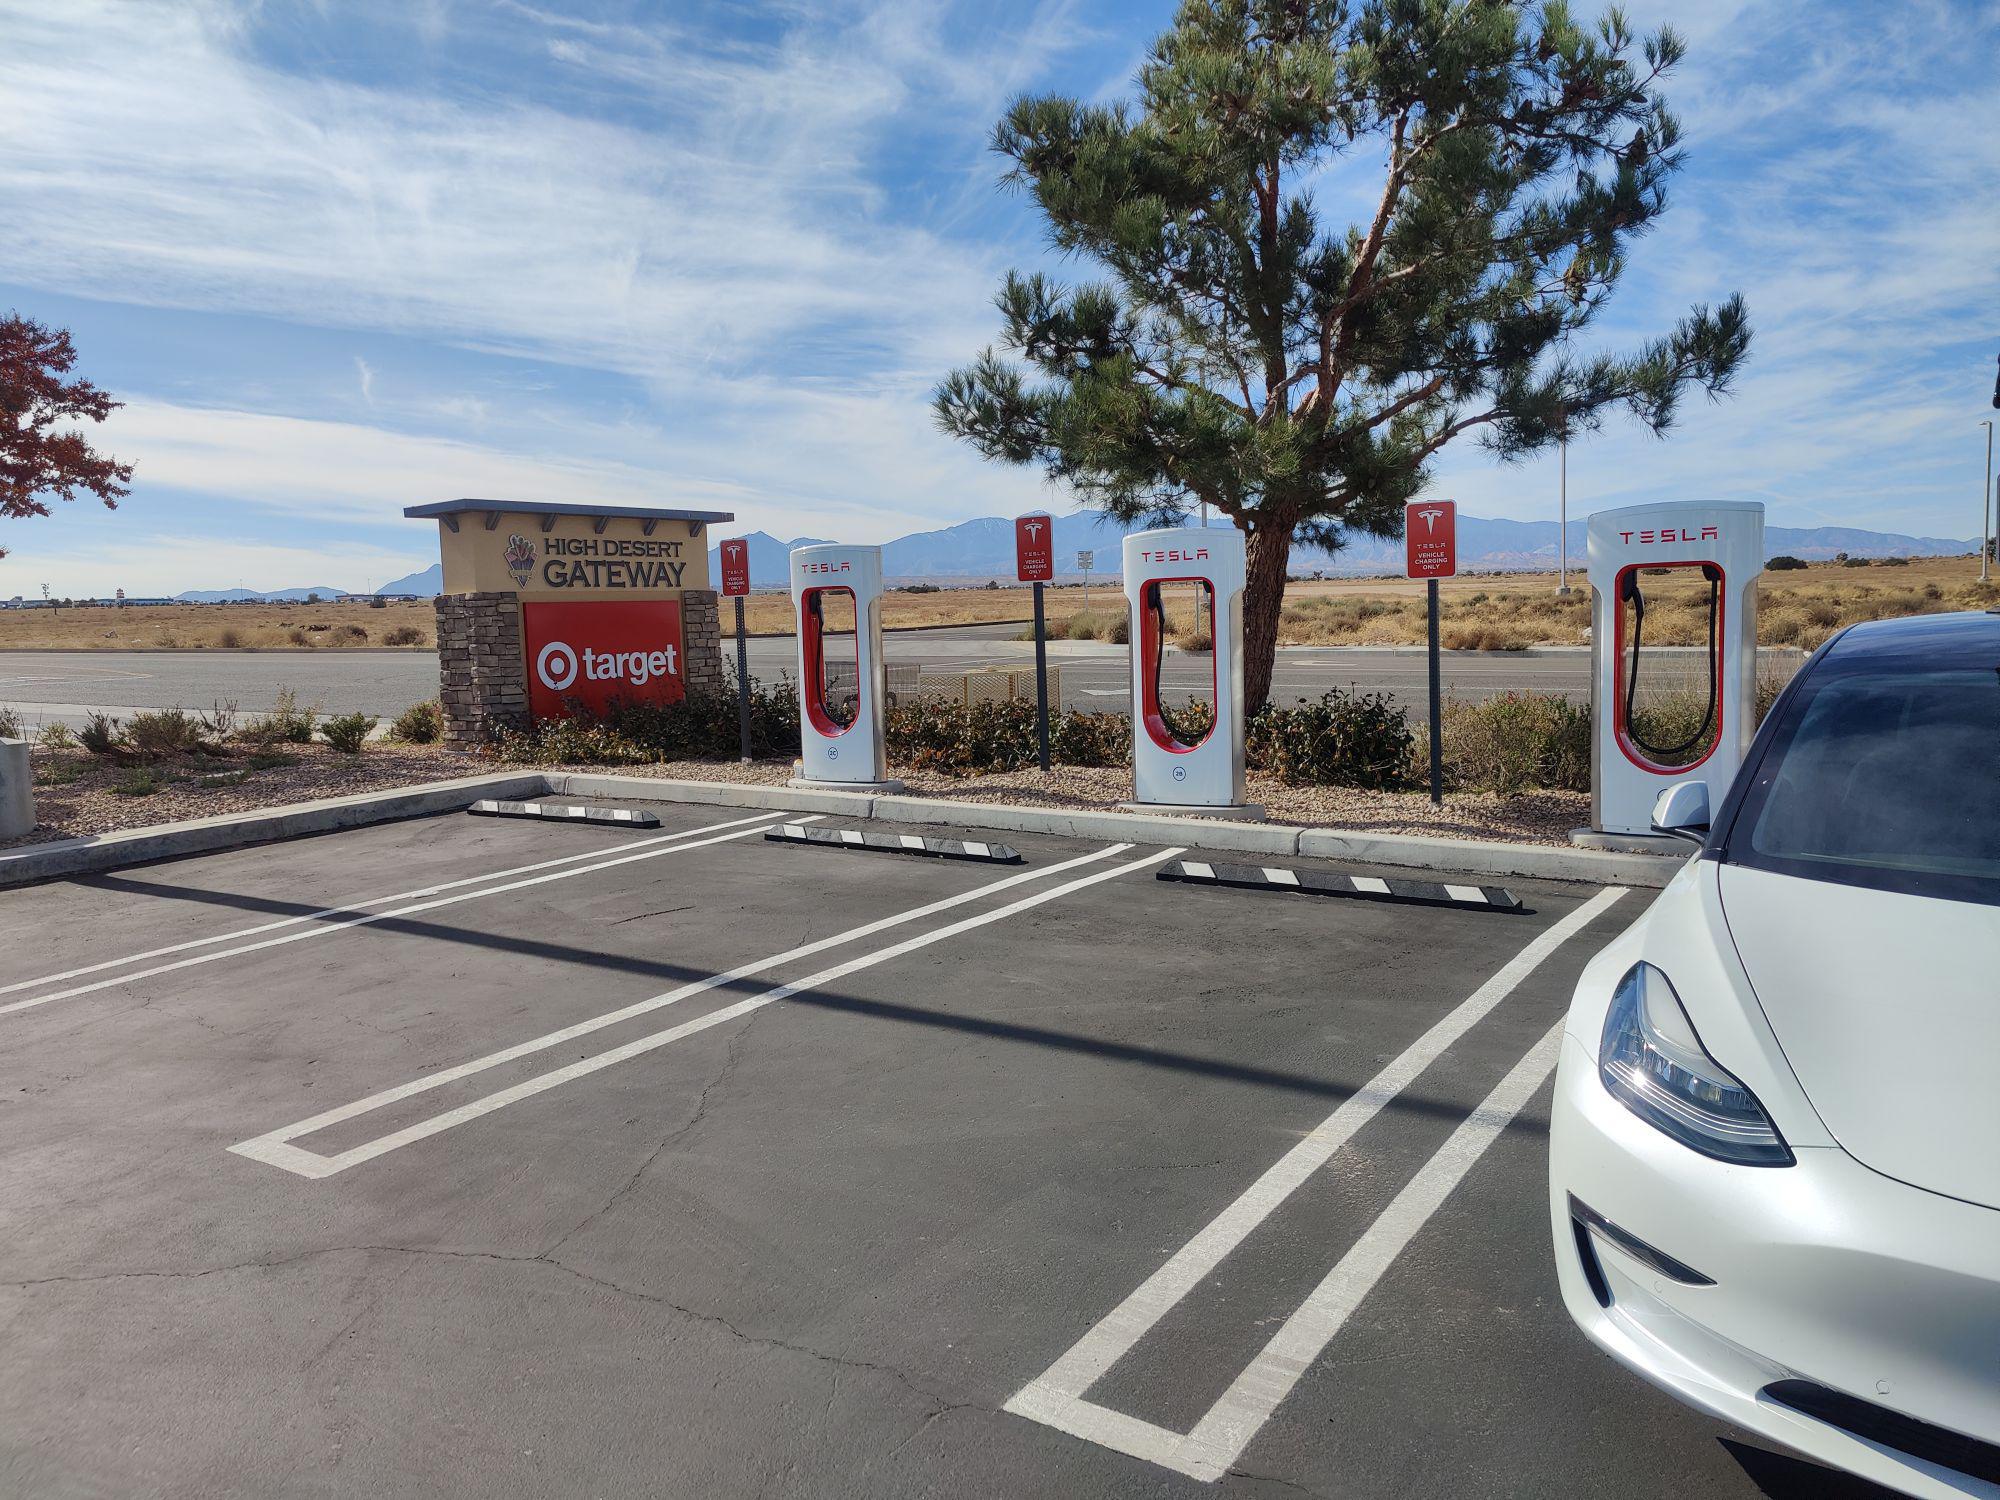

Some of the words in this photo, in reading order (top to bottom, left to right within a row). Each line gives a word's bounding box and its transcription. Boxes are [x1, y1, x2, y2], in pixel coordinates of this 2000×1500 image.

[1619, 527, 1718, 544] TESLA
[543, 538, 599, 556] HIGH
[603, 540, 683, 557] DESERT
[1141, 549, 1208, 562] TESLA
[543, 559, 687, 588] GATEWAY
[801, 562, 850, 573] TESLA
[582, 644, 678, 686] target
